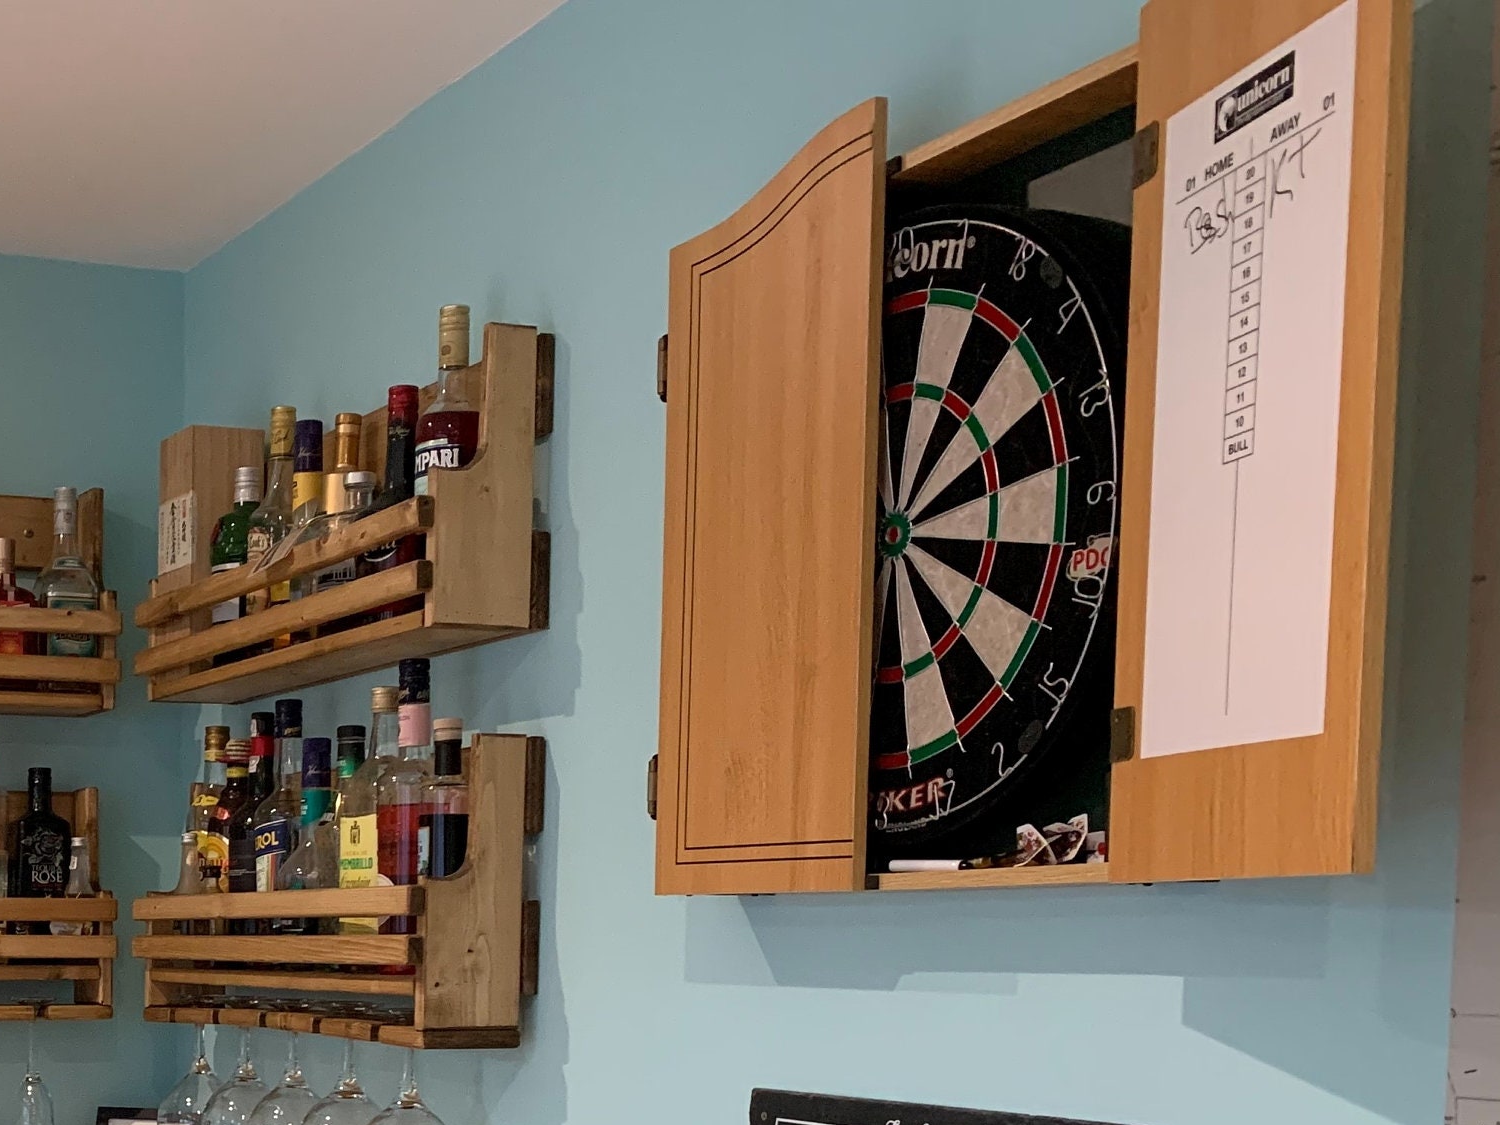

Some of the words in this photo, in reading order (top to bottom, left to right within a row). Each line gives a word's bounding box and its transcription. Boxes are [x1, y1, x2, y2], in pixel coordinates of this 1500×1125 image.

[1270, 112, 1301, 143] AWAY
[1204, 152, 1234, 181] HOME
[1245, 166, 1256, 180] 20
[1245, 191, 1255, 204] 19
[1244, 217, 1254, 229] 18
[1243, 241, 1252, 254] 17
[888, 238, 966, 279] corn
[1242, 267, 1251, 279] 16
[1241, 292, 1250, 304] 15
[1240, 316, 1249, 328] 14
[1238, 342, 1248, 354] 13
[1237, 366, 1247, 378] 12
[1237, 391, 1245, 403] 11
[1235, 416, 1244, 428] 10
[1228, 440, 1249, 454] BULL
[414, 447, 460, 475] MPARI
[31, 863, 62, 871] TEQUILA
[31, 870, 63, 884] ROSE
